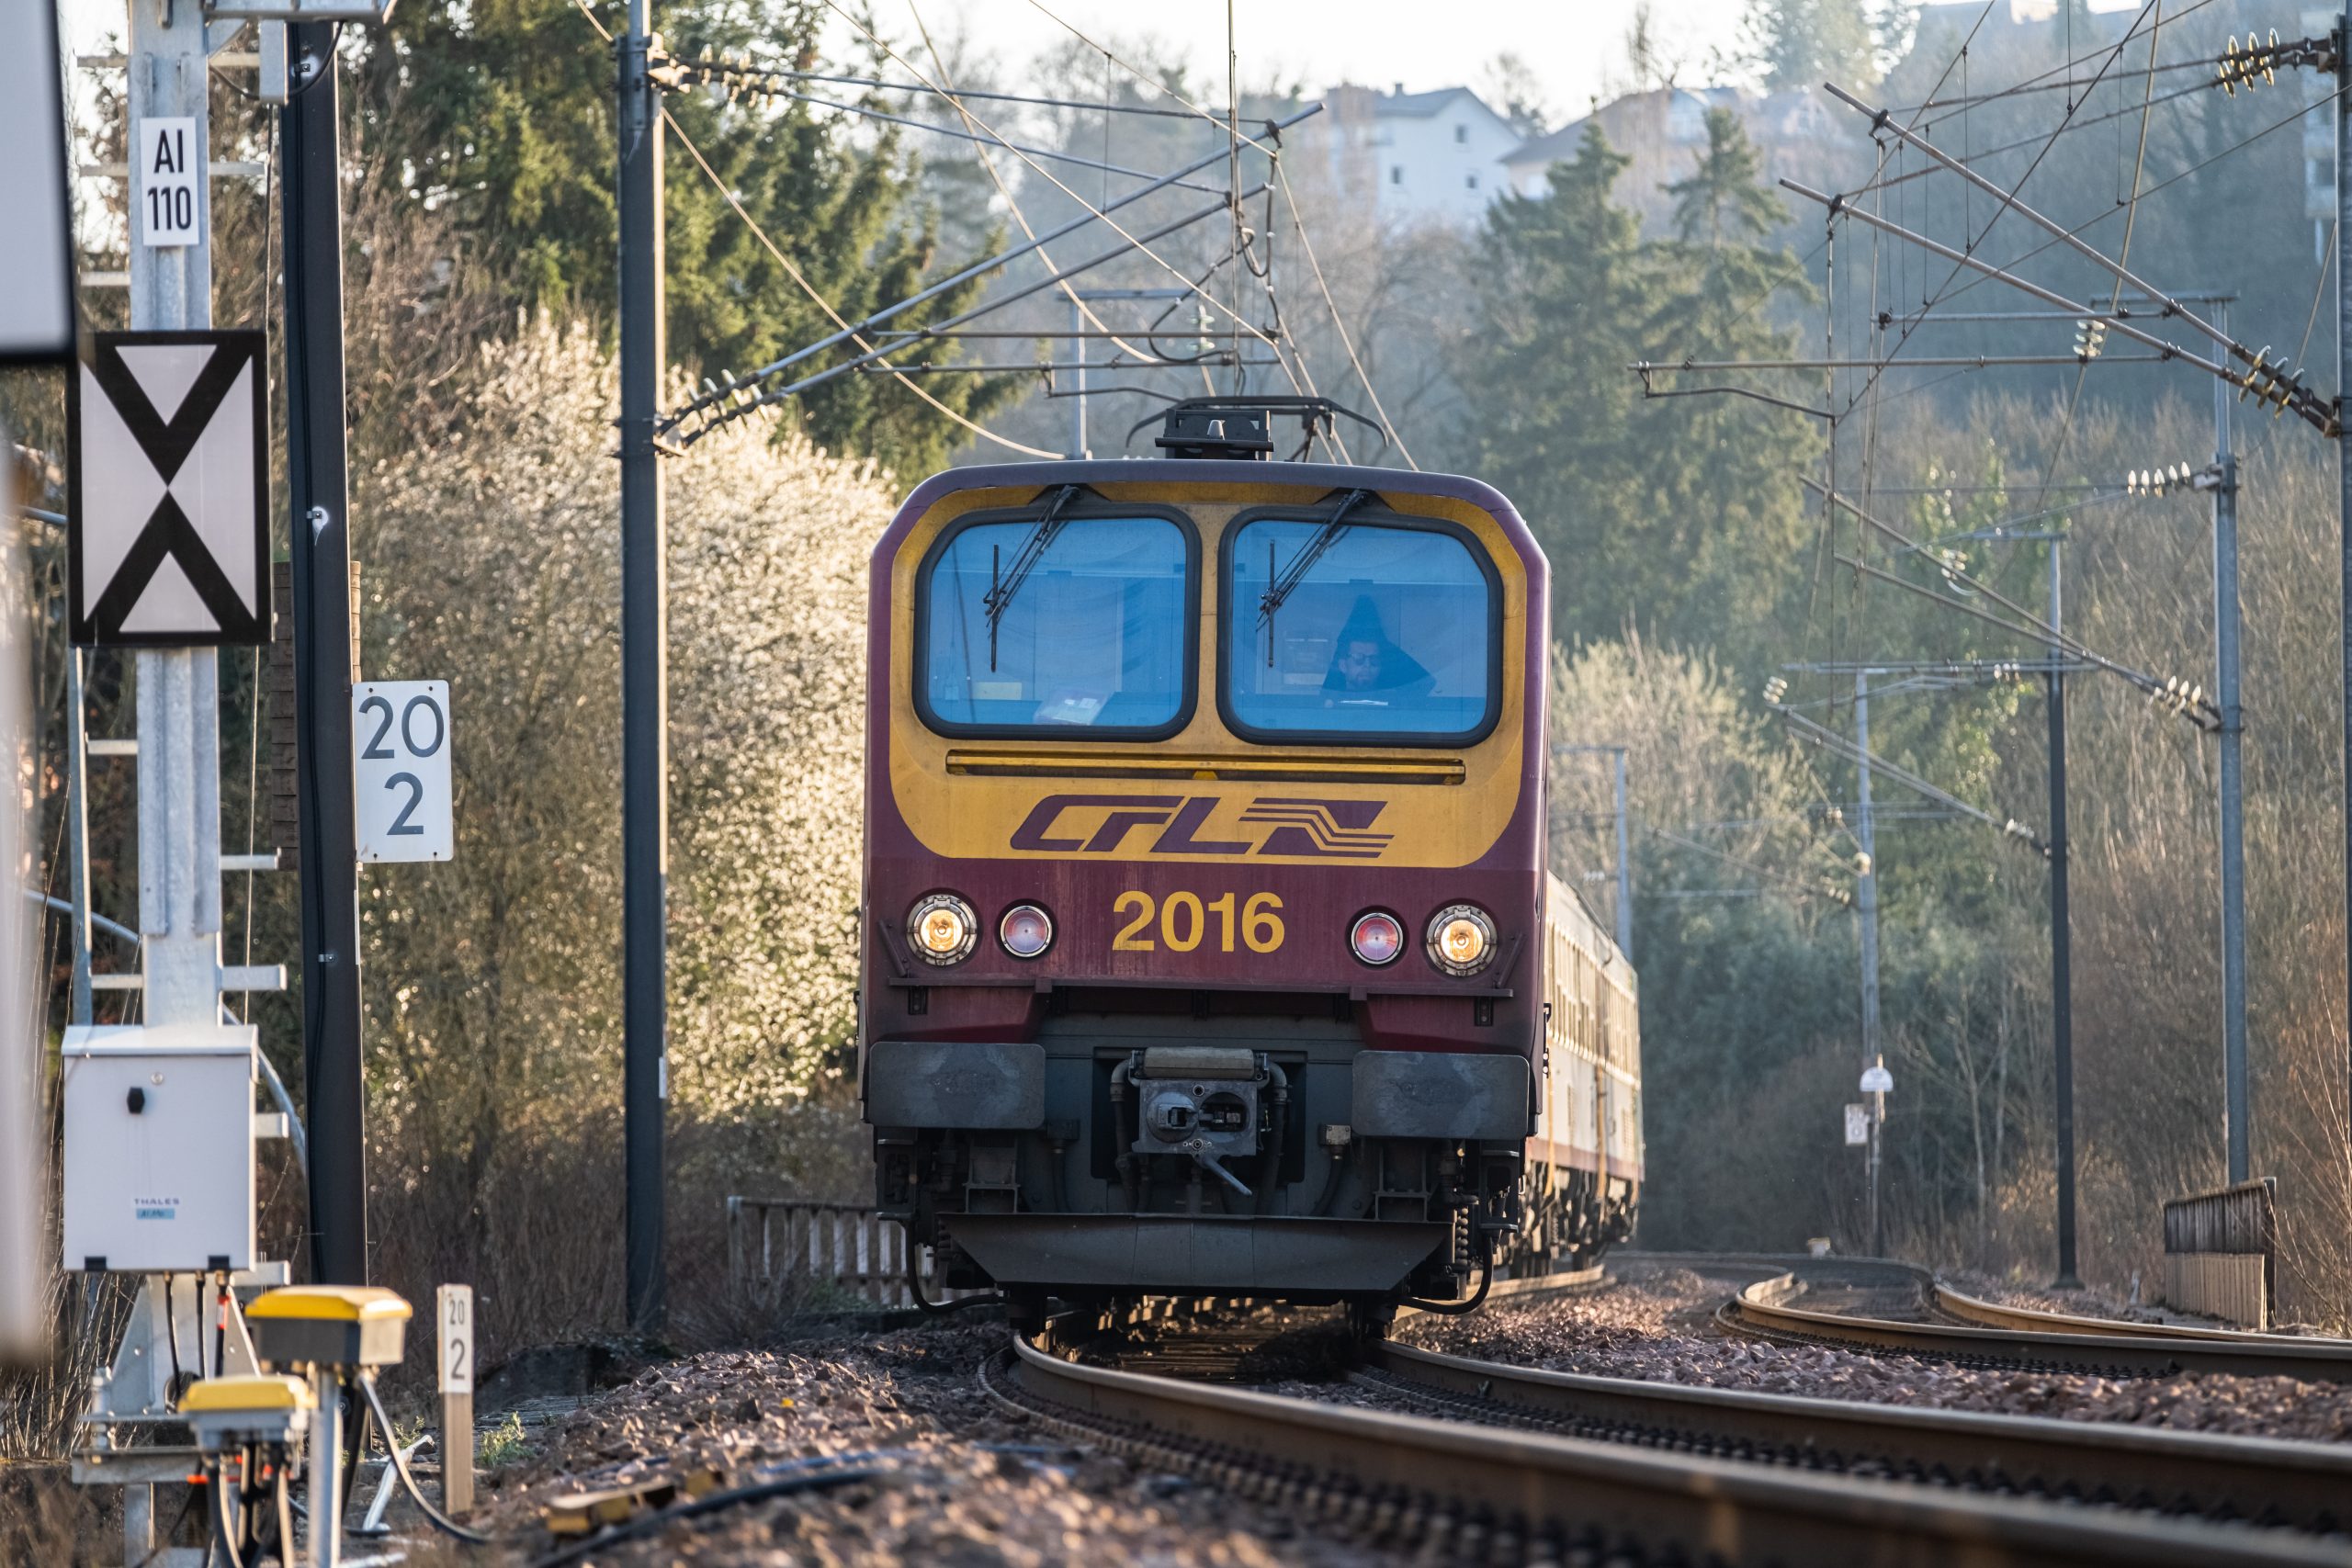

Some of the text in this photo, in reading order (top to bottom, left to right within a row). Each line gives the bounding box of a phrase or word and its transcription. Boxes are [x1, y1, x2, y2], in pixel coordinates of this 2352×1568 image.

[147, 185, 192, 231] 110
[358, 694, 445, 760] 20
[384, 772, 424, 836] 2
[1010, 794, 1254, 855] CFL
[1112, 889, 1285, 954] 2016
[134, 1197, 180, 1206] THALES
[448, 1299, 465, 1325] 20
[450, 1337, 466, 1381] 2
